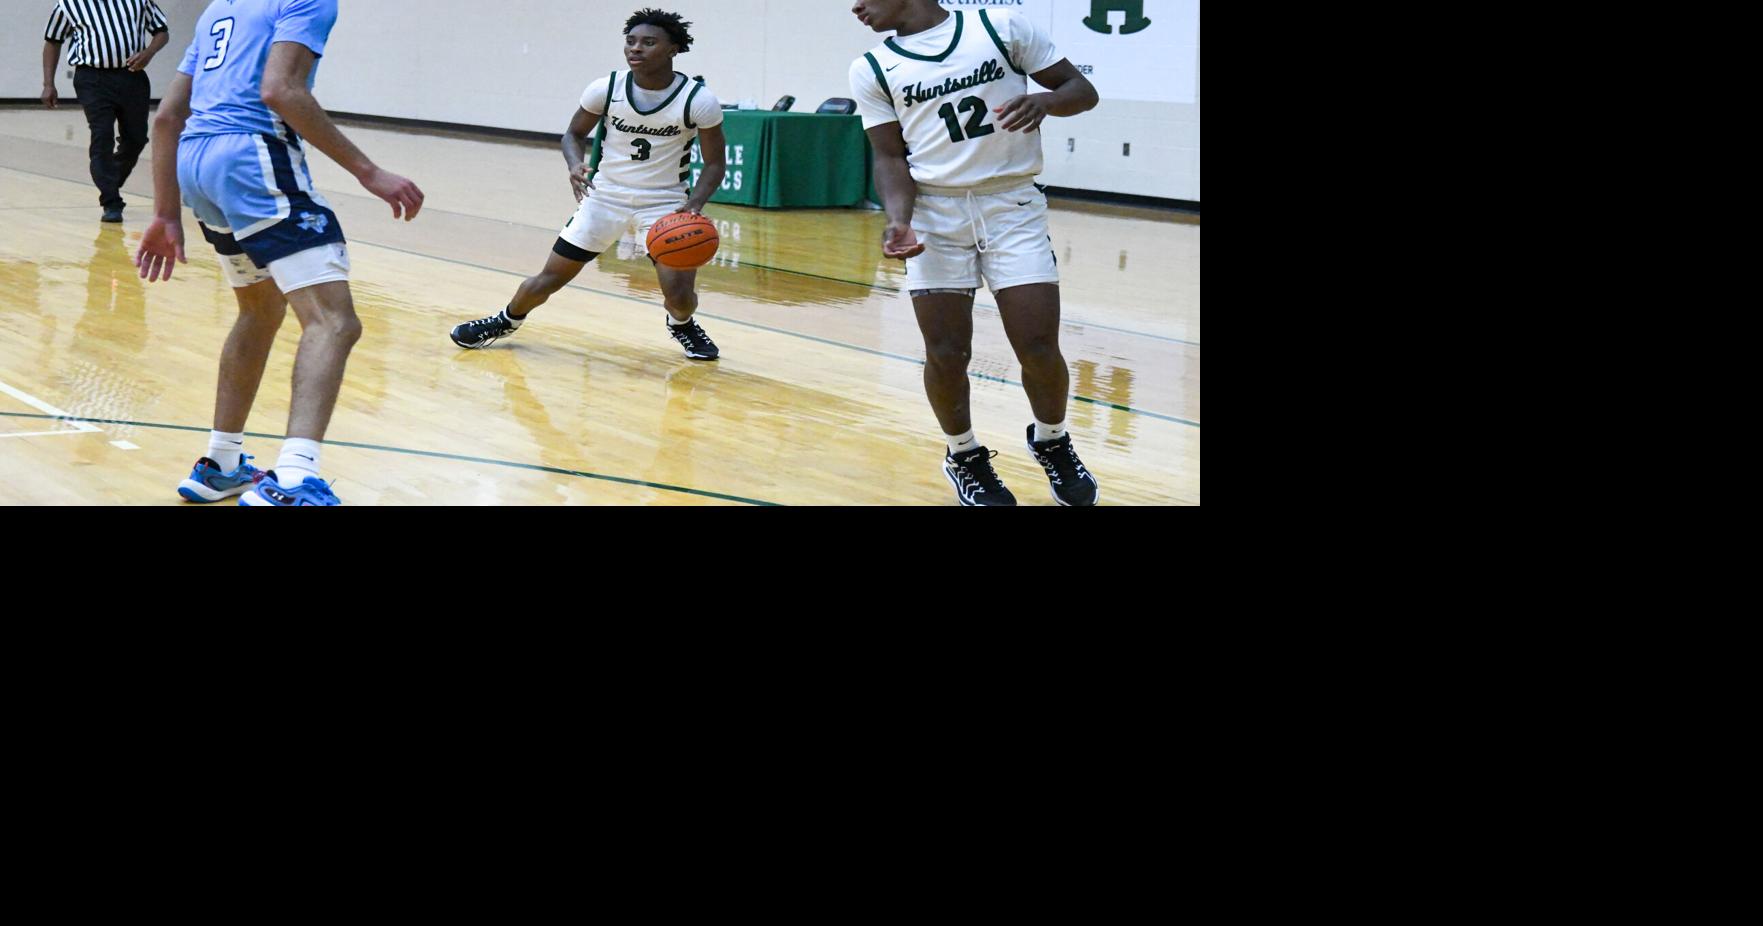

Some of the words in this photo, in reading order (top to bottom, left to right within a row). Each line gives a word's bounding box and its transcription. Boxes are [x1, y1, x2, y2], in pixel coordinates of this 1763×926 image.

[203, 16, 236, 72] 3
[902, 58, 1005, 107] Huntsville
[611, 116, 681, 137] Huntsville
[938, 95, 995, 143] 12
[630, 137, 652, 161] 3
